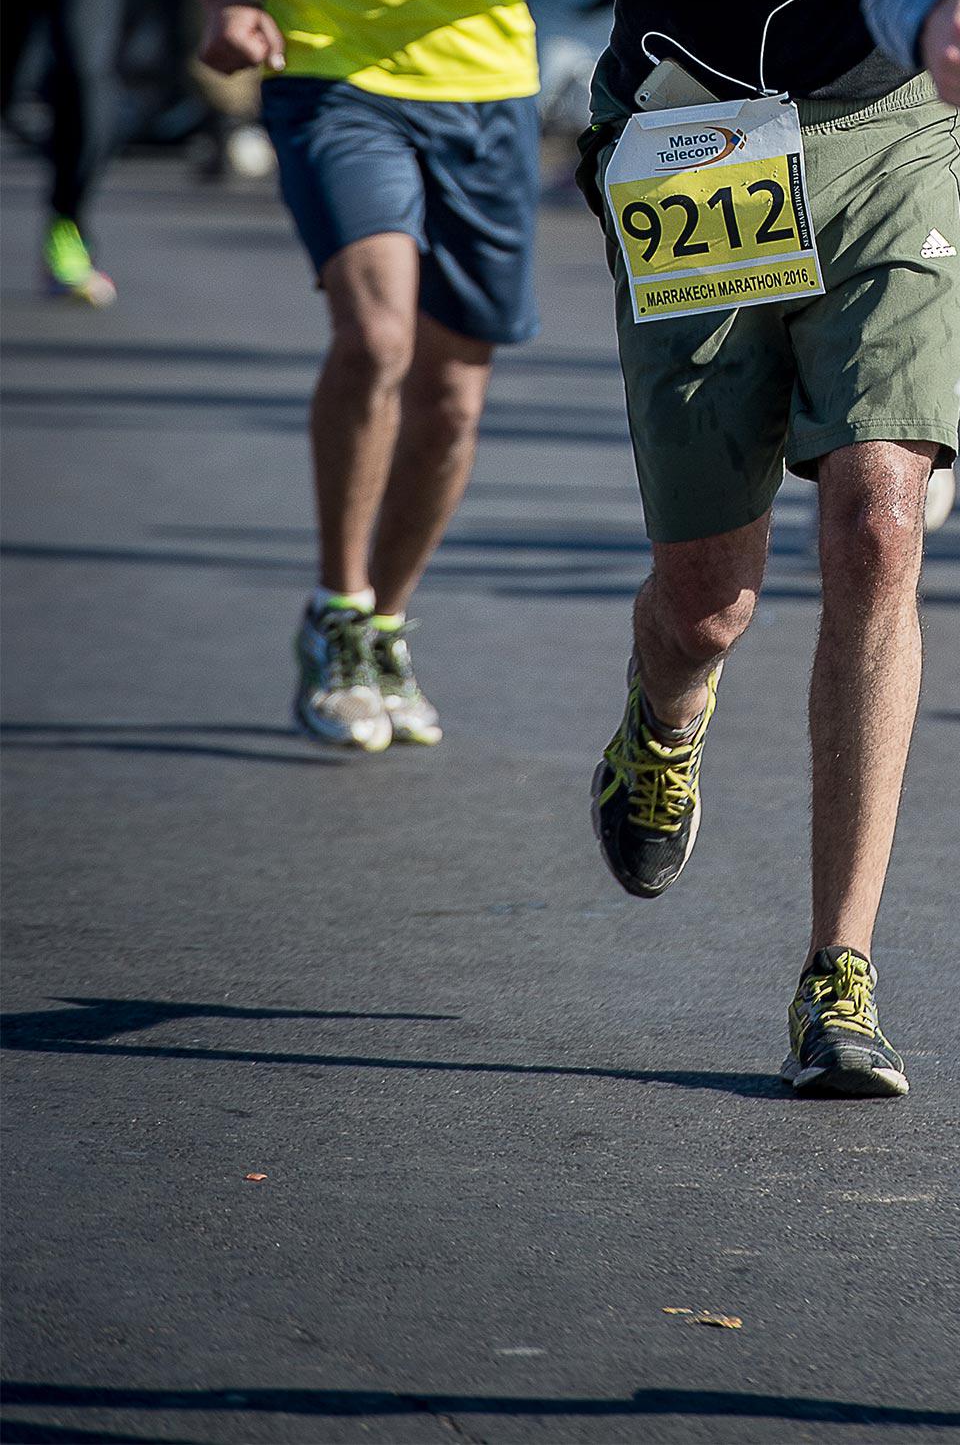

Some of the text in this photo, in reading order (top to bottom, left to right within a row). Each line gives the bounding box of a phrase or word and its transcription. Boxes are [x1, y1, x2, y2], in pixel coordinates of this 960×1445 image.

[656, 145, 719, 163] Telecom
[669, 132, 717, 149] Maroc
[621, 178, 795, 263] 9212
[646, 268, 809, 307] MARRAKECH MARATHON 2016
